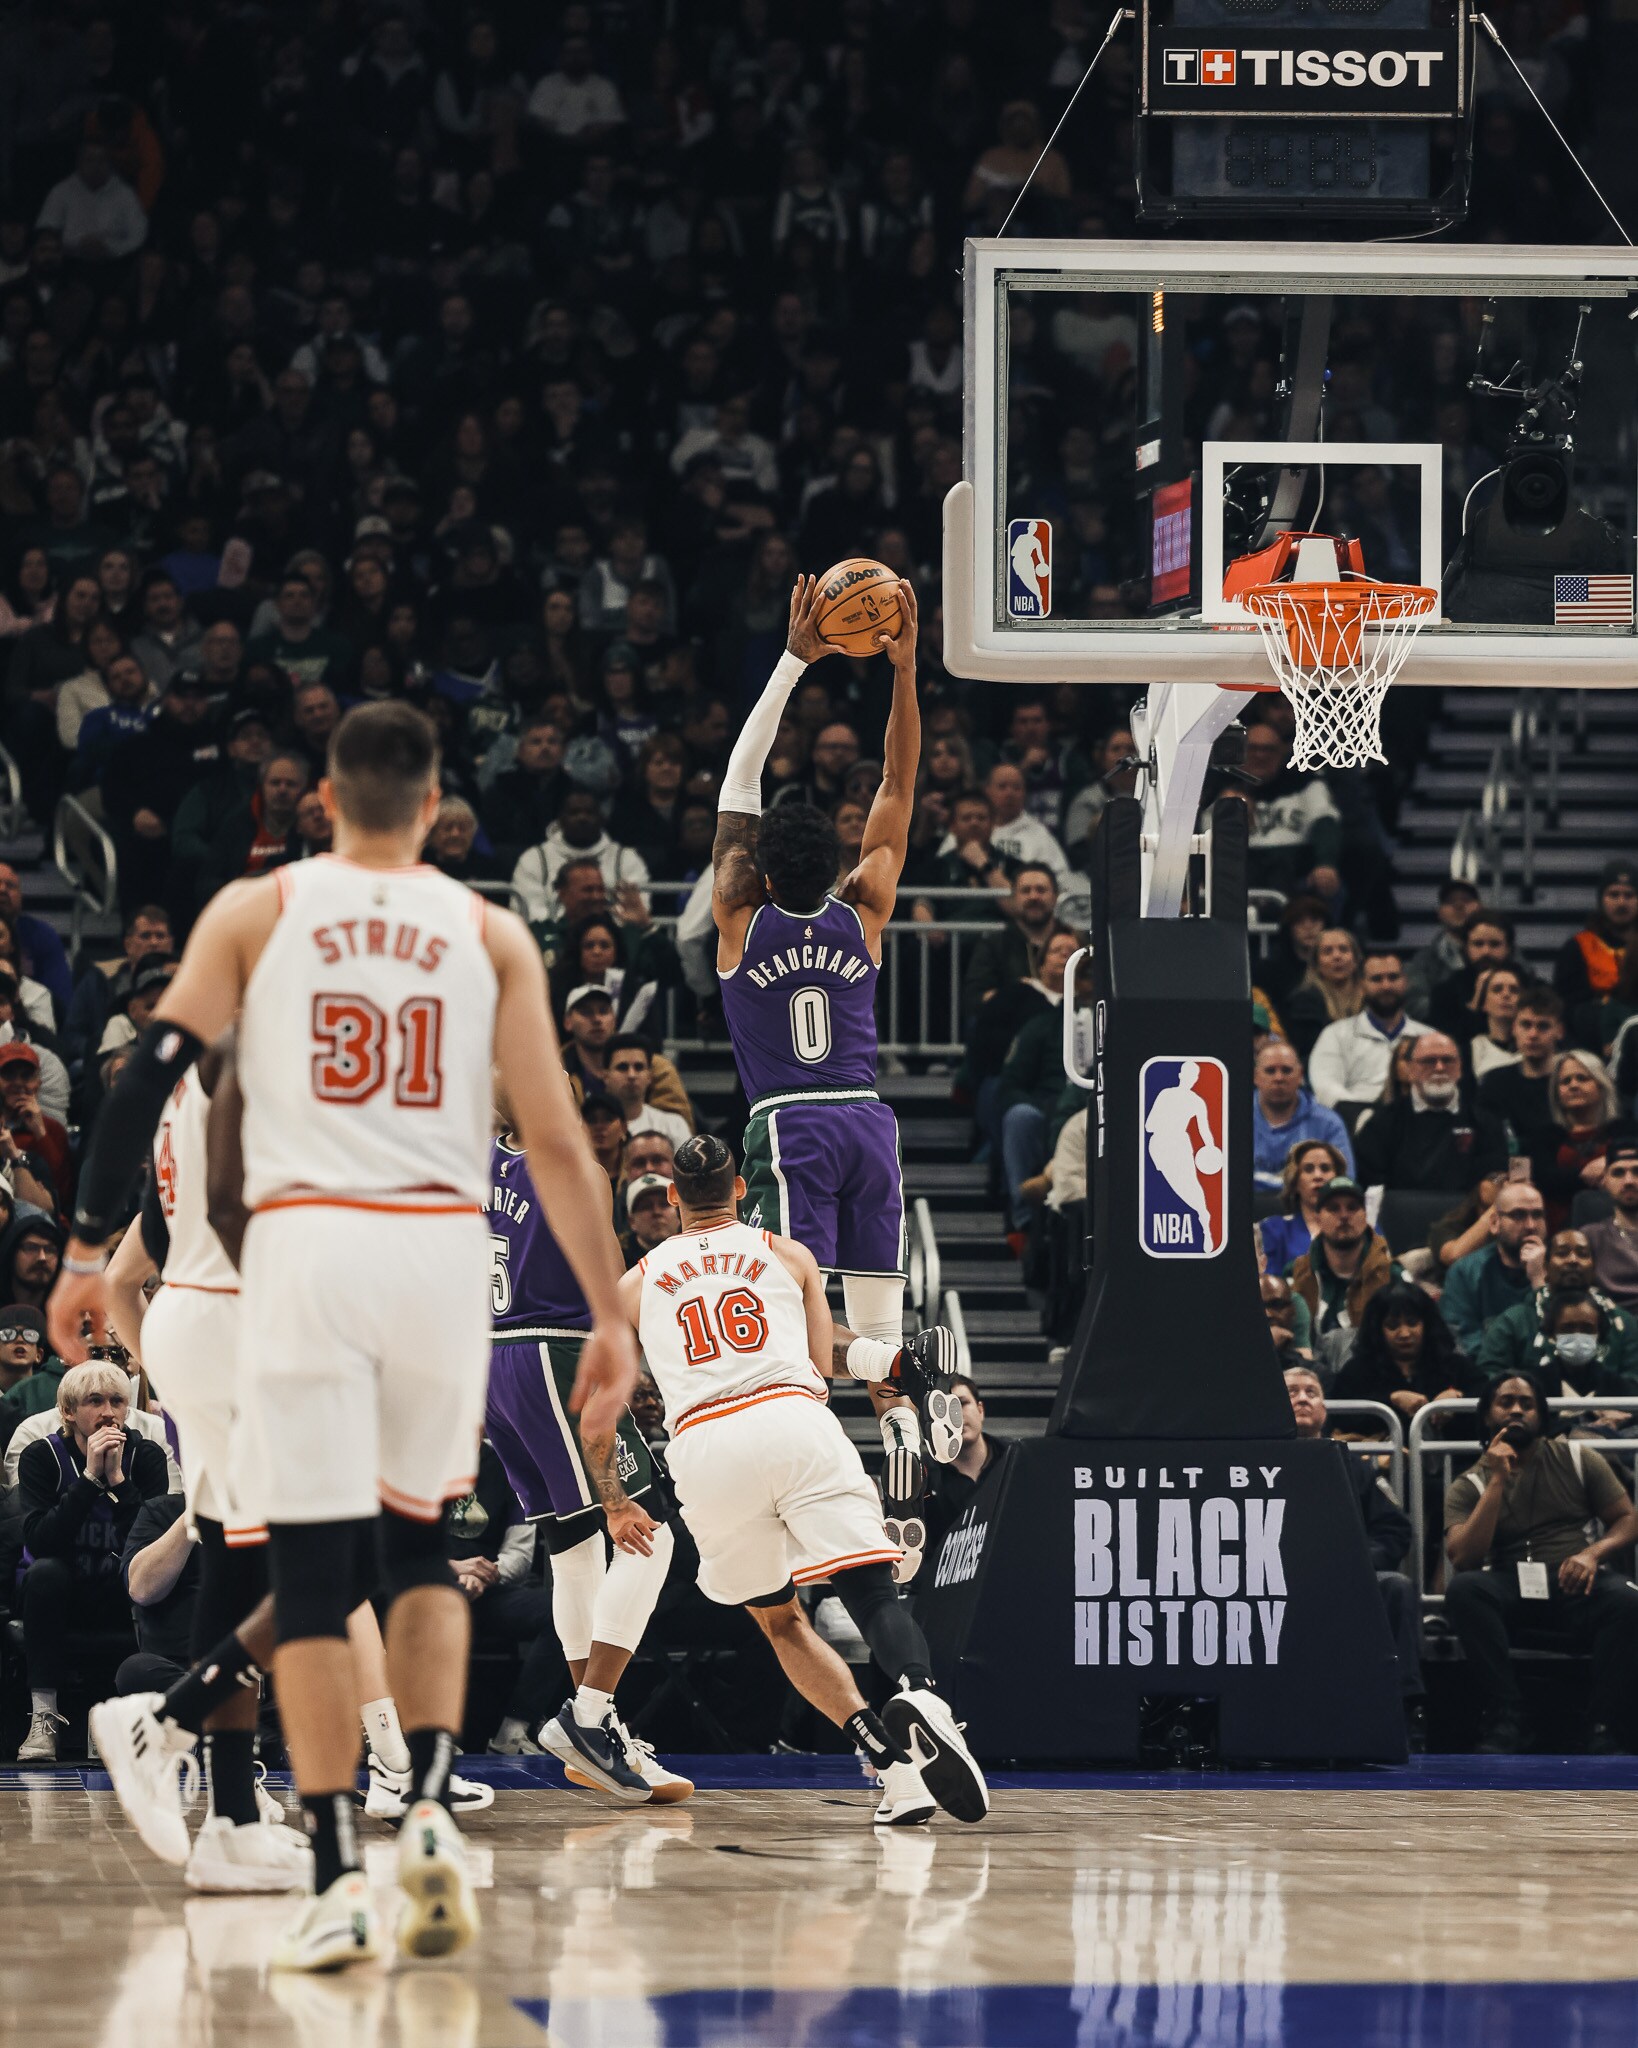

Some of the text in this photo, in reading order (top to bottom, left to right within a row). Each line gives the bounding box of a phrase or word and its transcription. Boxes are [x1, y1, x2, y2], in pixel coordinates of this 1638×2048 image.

[1241, 50, 1444, 87] TISSOT
[825, 567, 884, 601] Wilson
[1014, 596, 1035, 612] NBA
[312, 918, 449, 973] STRUS
[746, 944, 869, 989] BEAUCHAMP
[788, 985, 832, 1065] 0
[311, 992, 443, 1109] 31
[1153, 1213, 1194, 1244] NBA
[653, 1252, 767, 1297] MARTIN
[675, 1286, 770, 1367] 16
[1073, 1466, 1282, 1489] BUILT BY
[1074, 1497, 1288, 1598] BLACK
[1074, 1600, 1287, 1666] HISTORY
